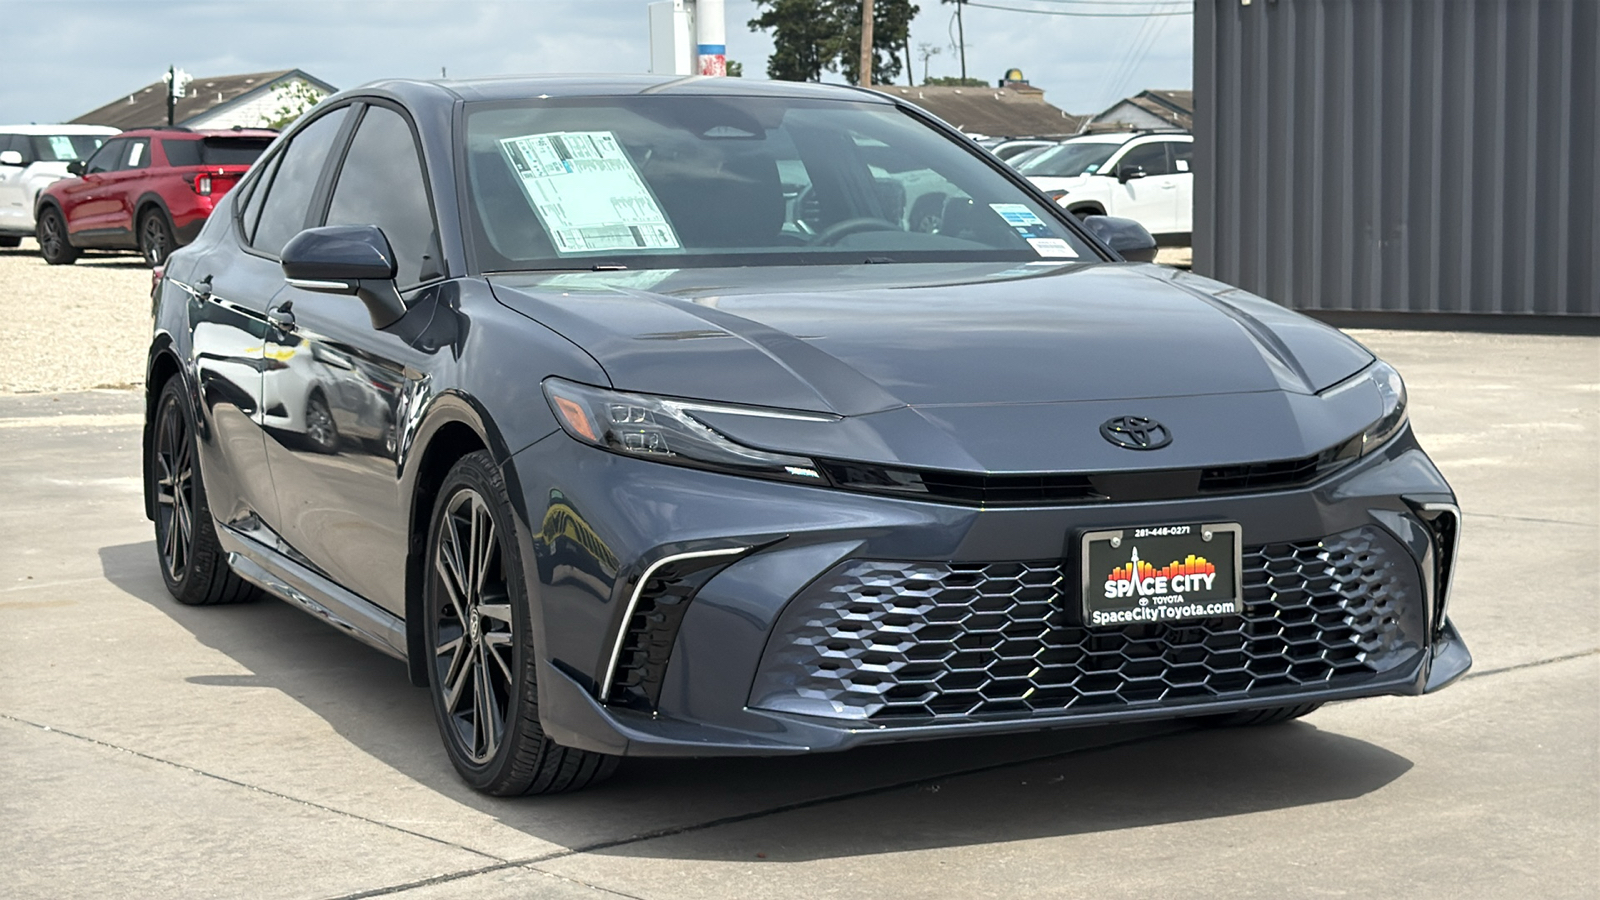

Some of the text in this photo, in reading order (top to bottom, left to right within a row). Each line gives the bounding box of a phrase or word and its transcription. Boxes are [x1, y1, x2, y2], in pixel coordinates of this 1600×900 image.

[1104, 572, 1216, 598] SPACE CITY
[1152, 595, 1184, 605] TOYOTA
[1092, 602, 1235, 625] SpaceCityToyota.com
